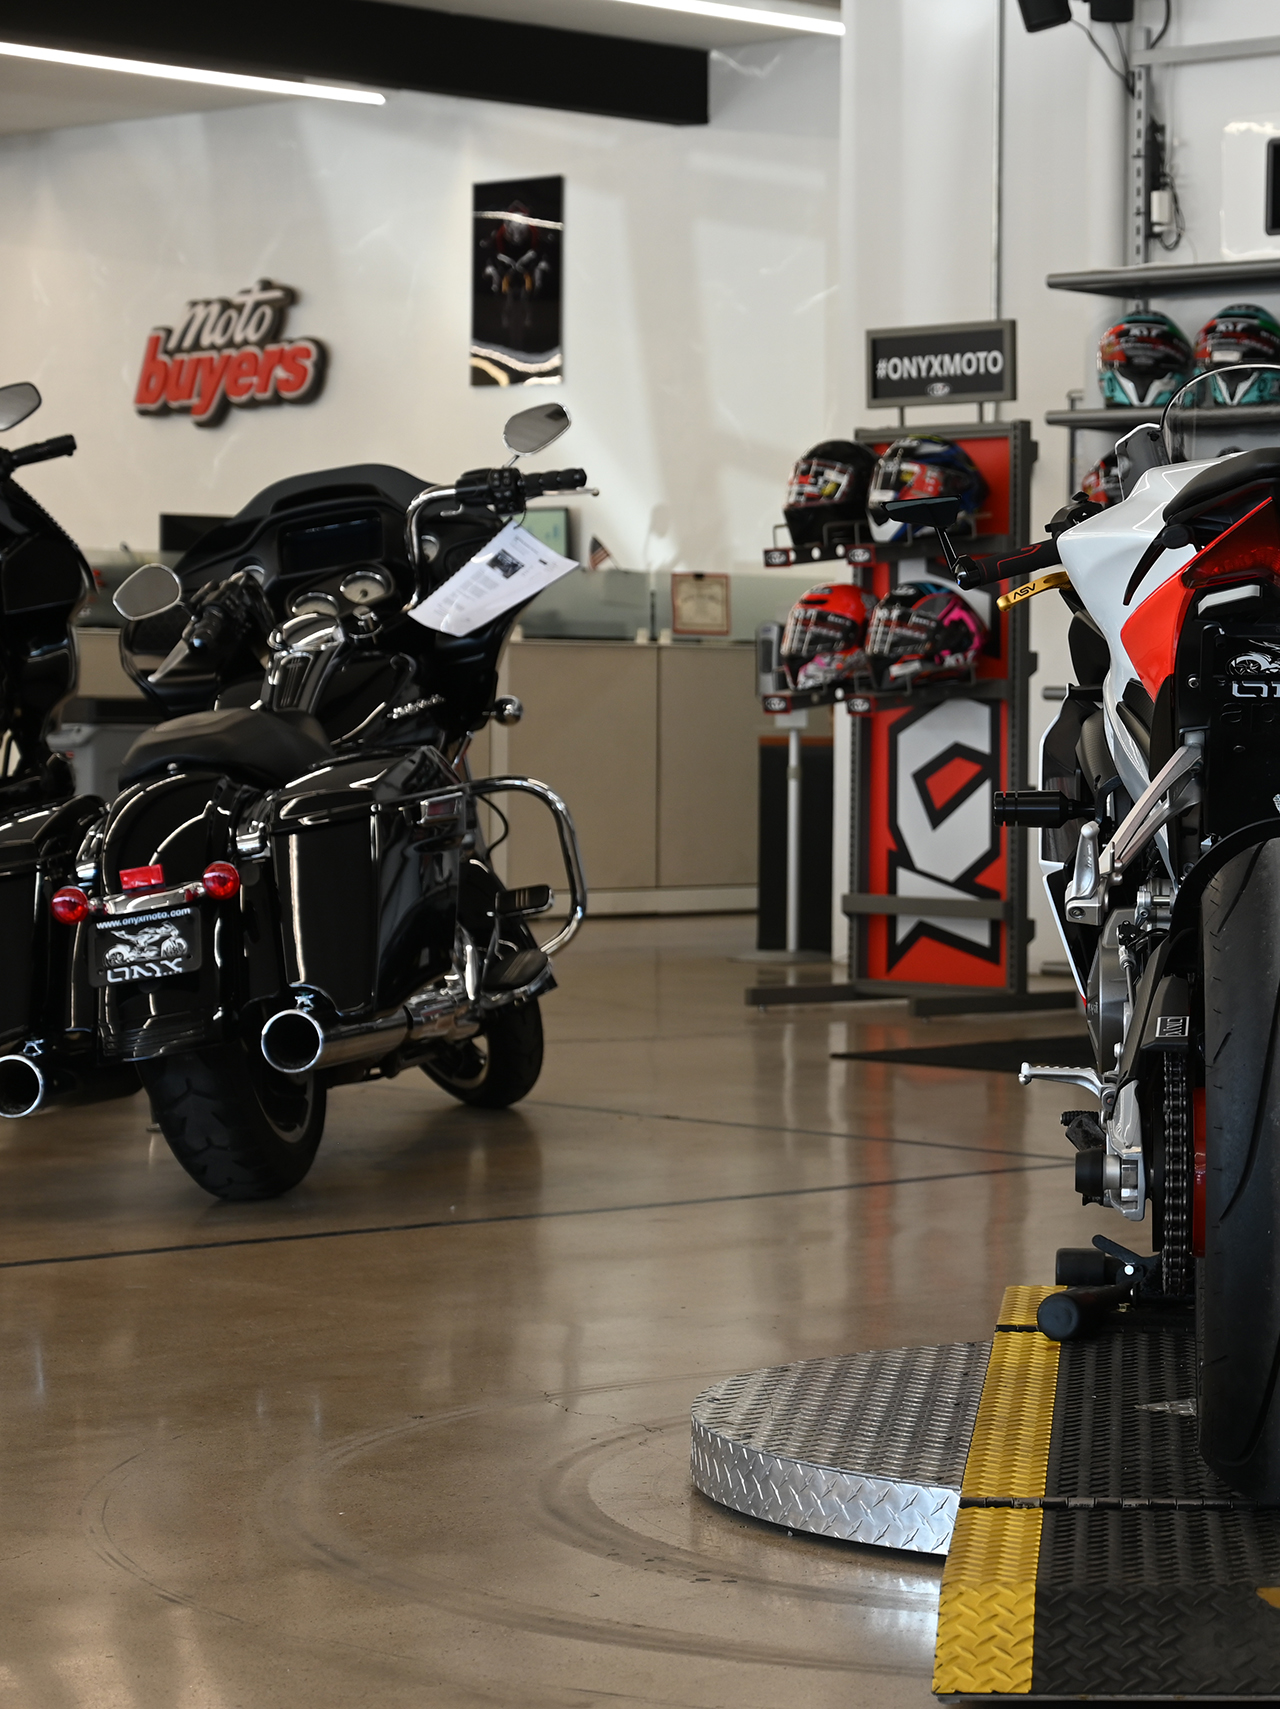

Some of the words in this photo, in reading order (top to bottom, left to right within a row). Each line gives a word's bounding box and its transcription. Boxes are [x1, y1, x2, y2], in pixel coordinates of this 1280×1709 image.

[134, 331, 314, 417] buyers
[876, 350, 1004, 381] #ONYXMOTO
[1013, 583, 1036, 600] ASV
[96, 907, 191, 930] www.onyxmoto.com
